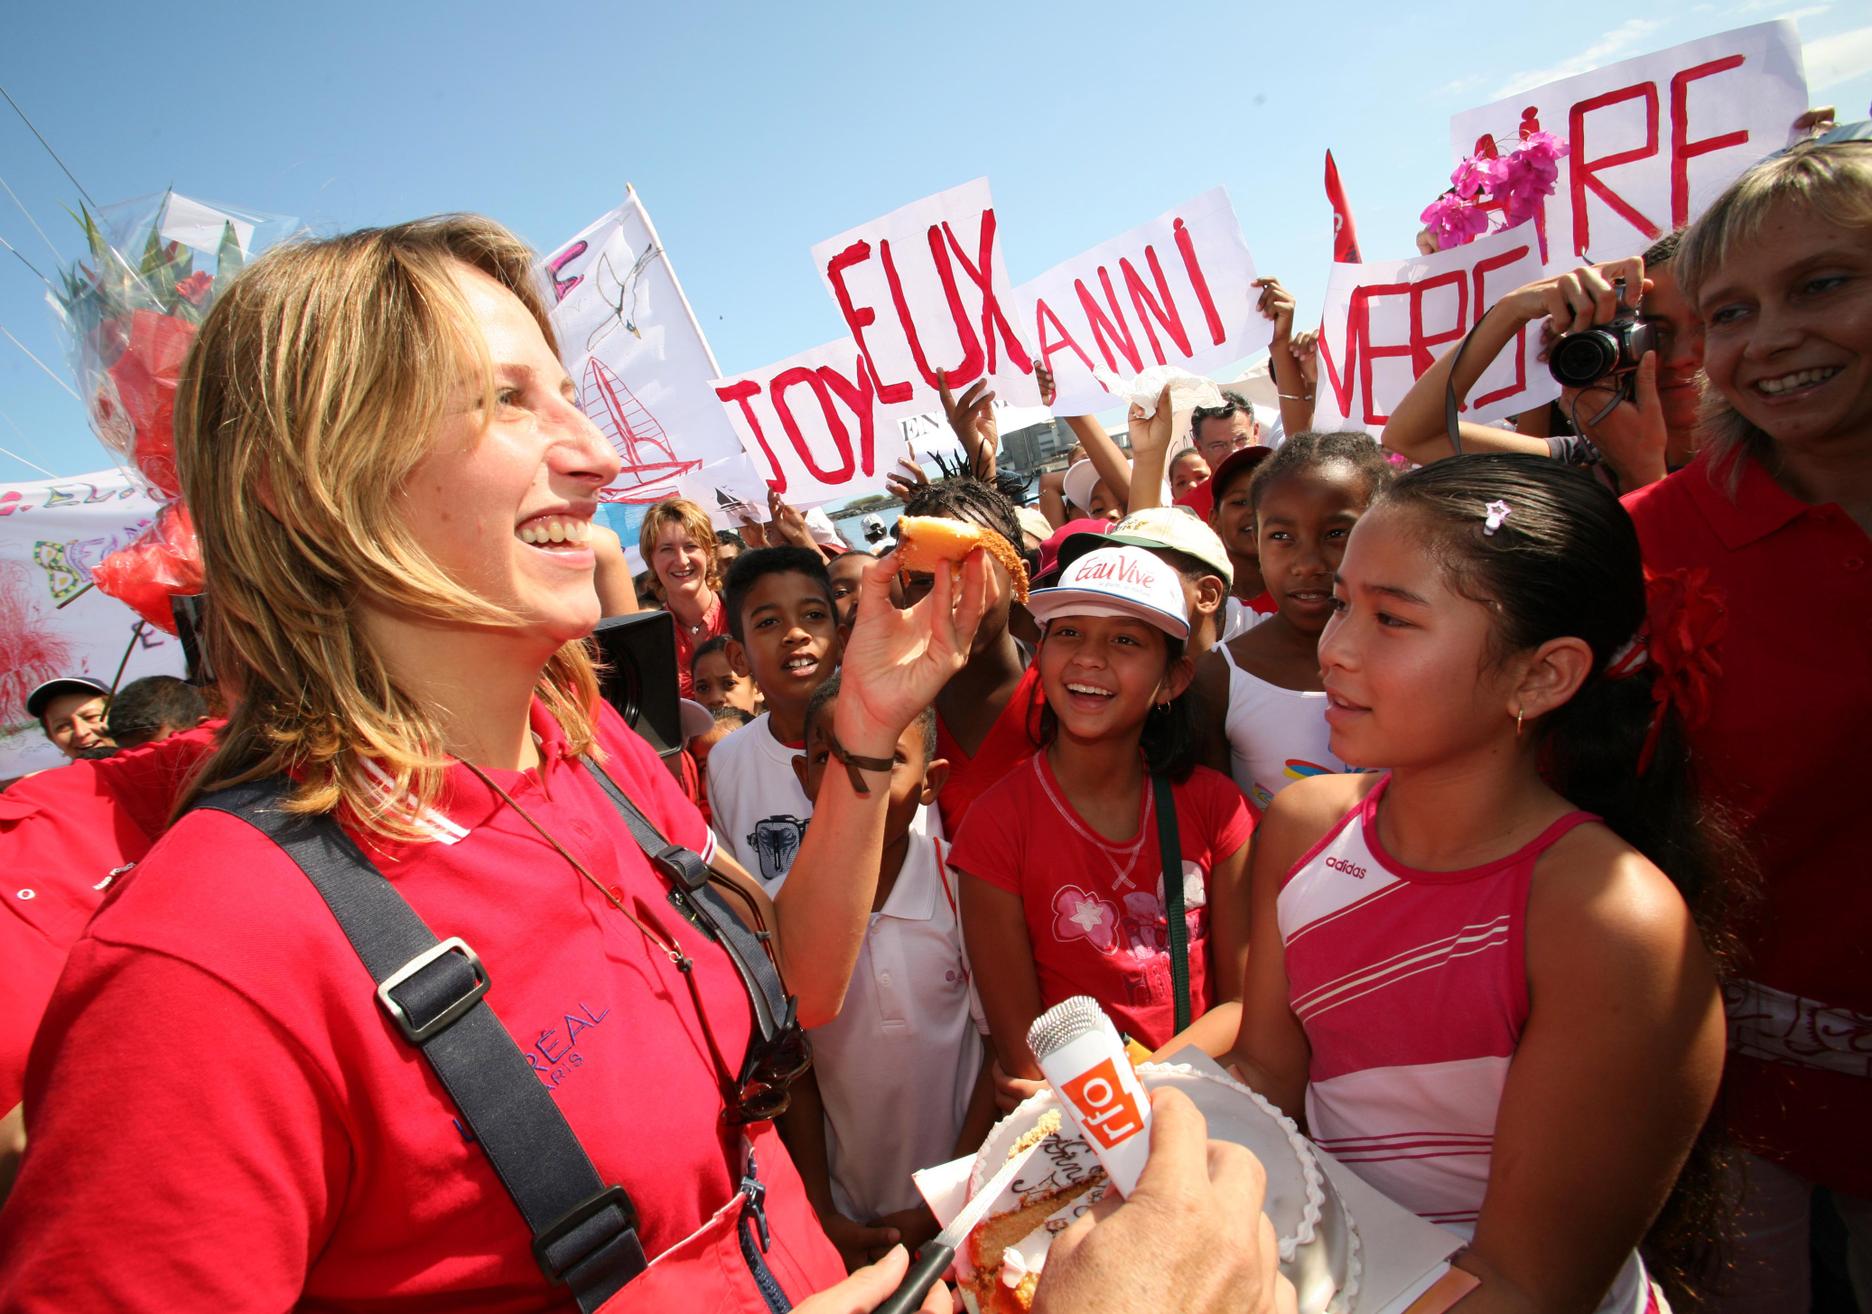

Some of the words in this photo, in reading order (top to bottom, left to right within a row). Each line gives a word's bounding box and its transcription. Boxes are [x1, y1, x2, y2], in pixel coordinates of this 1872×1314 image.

[828, 208, 1033, 404] EUX
[715, 354, 874, 493] JOY
[1075, 556, 1116, 582] Eau
[1119, 554, 1154, 588] Vive
[1325, 856, 1367, 880] adidas
